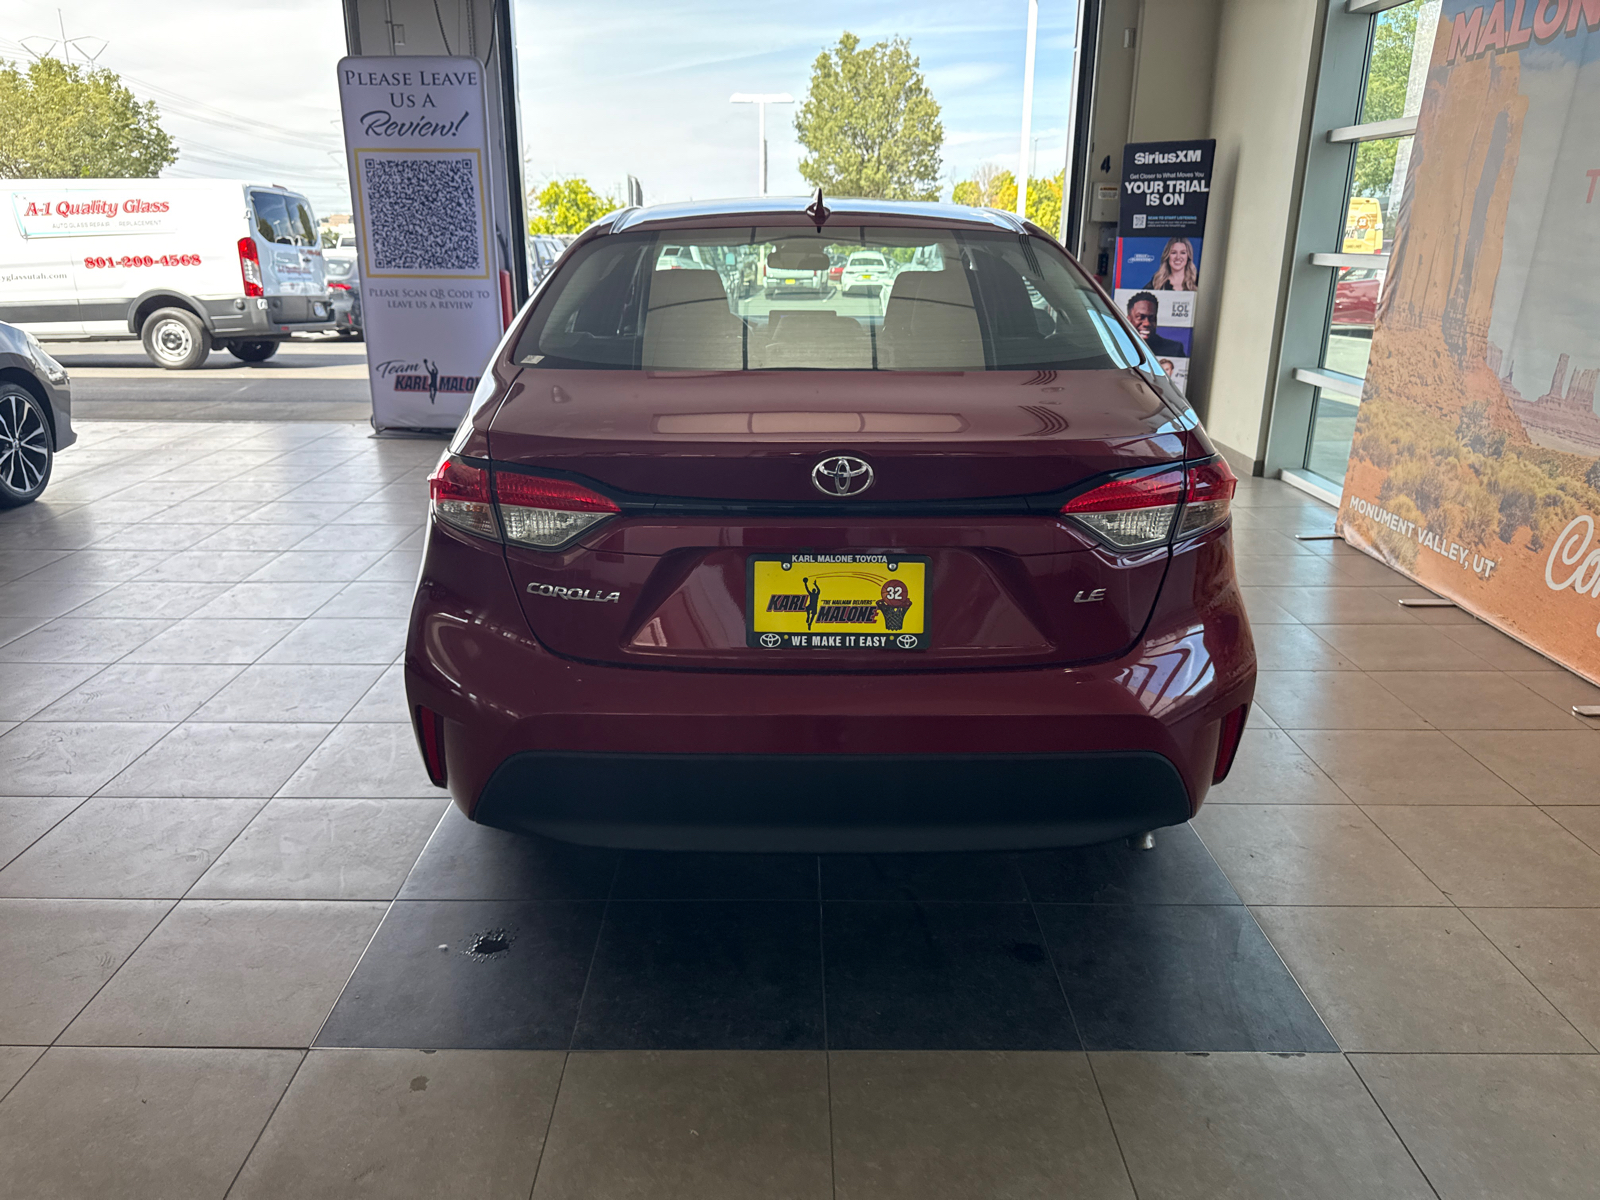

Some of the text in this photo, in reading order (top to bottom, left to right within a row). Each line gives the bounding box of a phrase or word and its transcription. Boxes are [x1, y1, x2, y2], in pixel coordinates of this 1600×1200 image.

[344, 70, 478, 86] PLEASE LEAVE
[389, 92, 437, 108] US A
[359, 110, 470, 137] Review!
[1100, 155, 1111, 174] 4
[1134, 149, 1202, 165] SiriusXM
[1125, 180, 1209, 194] YOUR TRIAL
[1146, 193, 1185, 206] IS ON
[24, 198, 170, 218] A-1 Quality Glass
[83, 253, 202, 269] 801-200-4568
[1, 273, 67, 282] yglassutah.com
[369, 288, 399, 298] PLEASE
[401, 288, 427, 298] SCAN
[430, 288, 445, 298] QR
[448, 289, 475, 298] CODE
[1172, 304, 1189, 312] LOL
[375, 359, 421, 378] Team
[394, 375, 429, 391] KARL
[1349, 495, 1496, 578] MONUMENT VALLEY, UT
[791, 555, 888, 563] KARL MALONE TOYOTA
[1545, 515, 1600, 598] Co
[526, 582, 620, 603] COROLLA
[886, 586, 903, 600] 32
[1073, 588, 1107, 603] LE
[766, 594, 809, 612] KARL
[815, 605, 878, 624] MALONE
[791, 636, 887, 647] WE MAKE IT EASY
